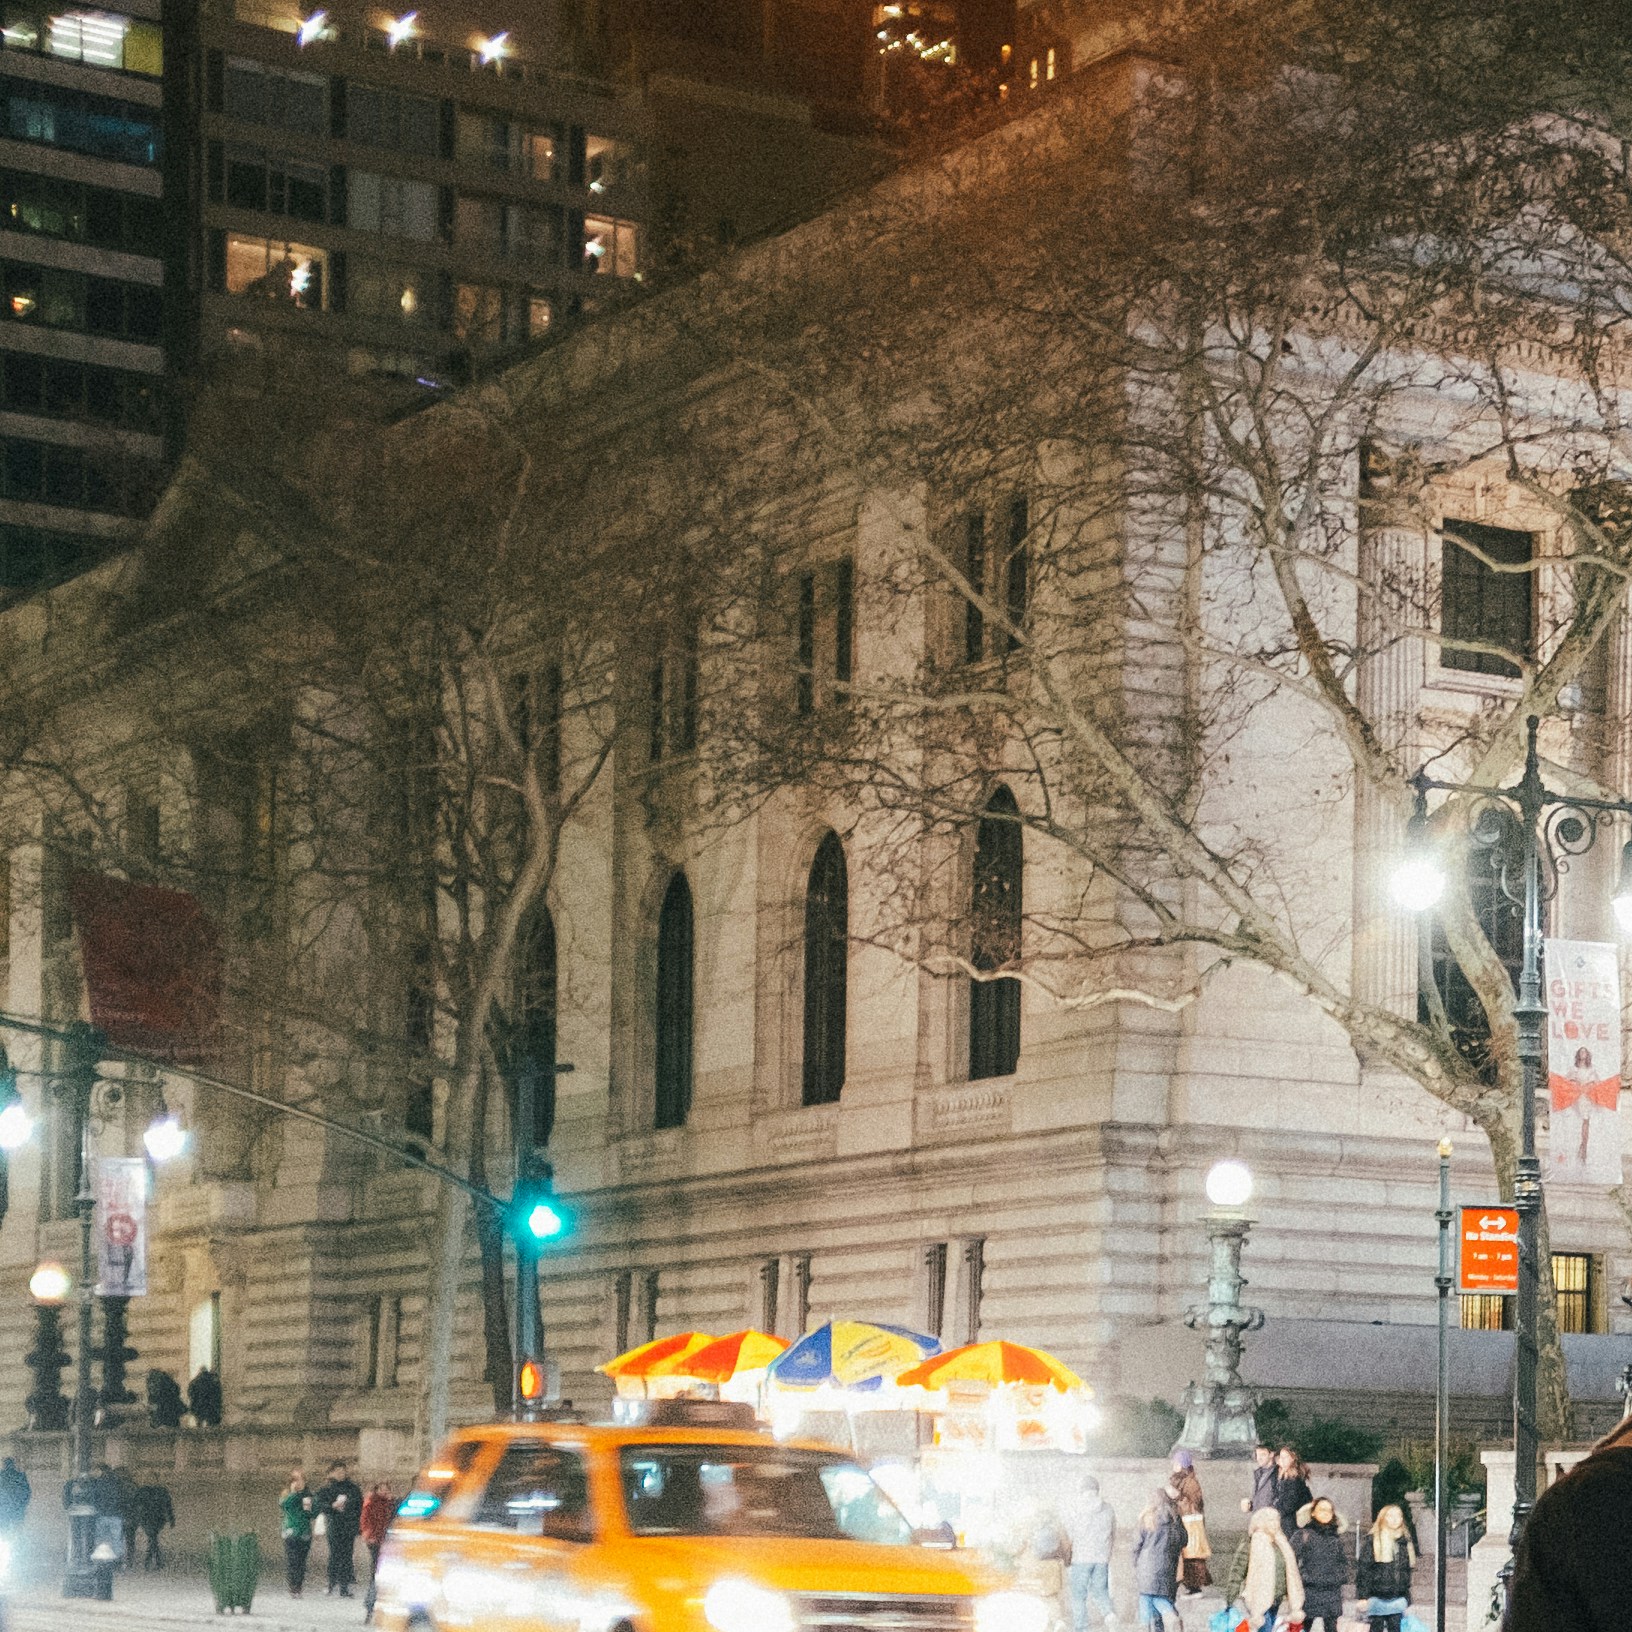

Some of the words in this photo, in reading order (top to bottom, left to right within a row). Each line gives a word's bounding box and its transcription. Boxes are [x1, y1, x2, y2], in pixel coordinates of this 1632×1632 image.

[1551, 979, 1616, 1000] GIFTS
[1551, 1001, 1584, 1020] WE
[1552, 1020, 1610, 1041] LOVE
